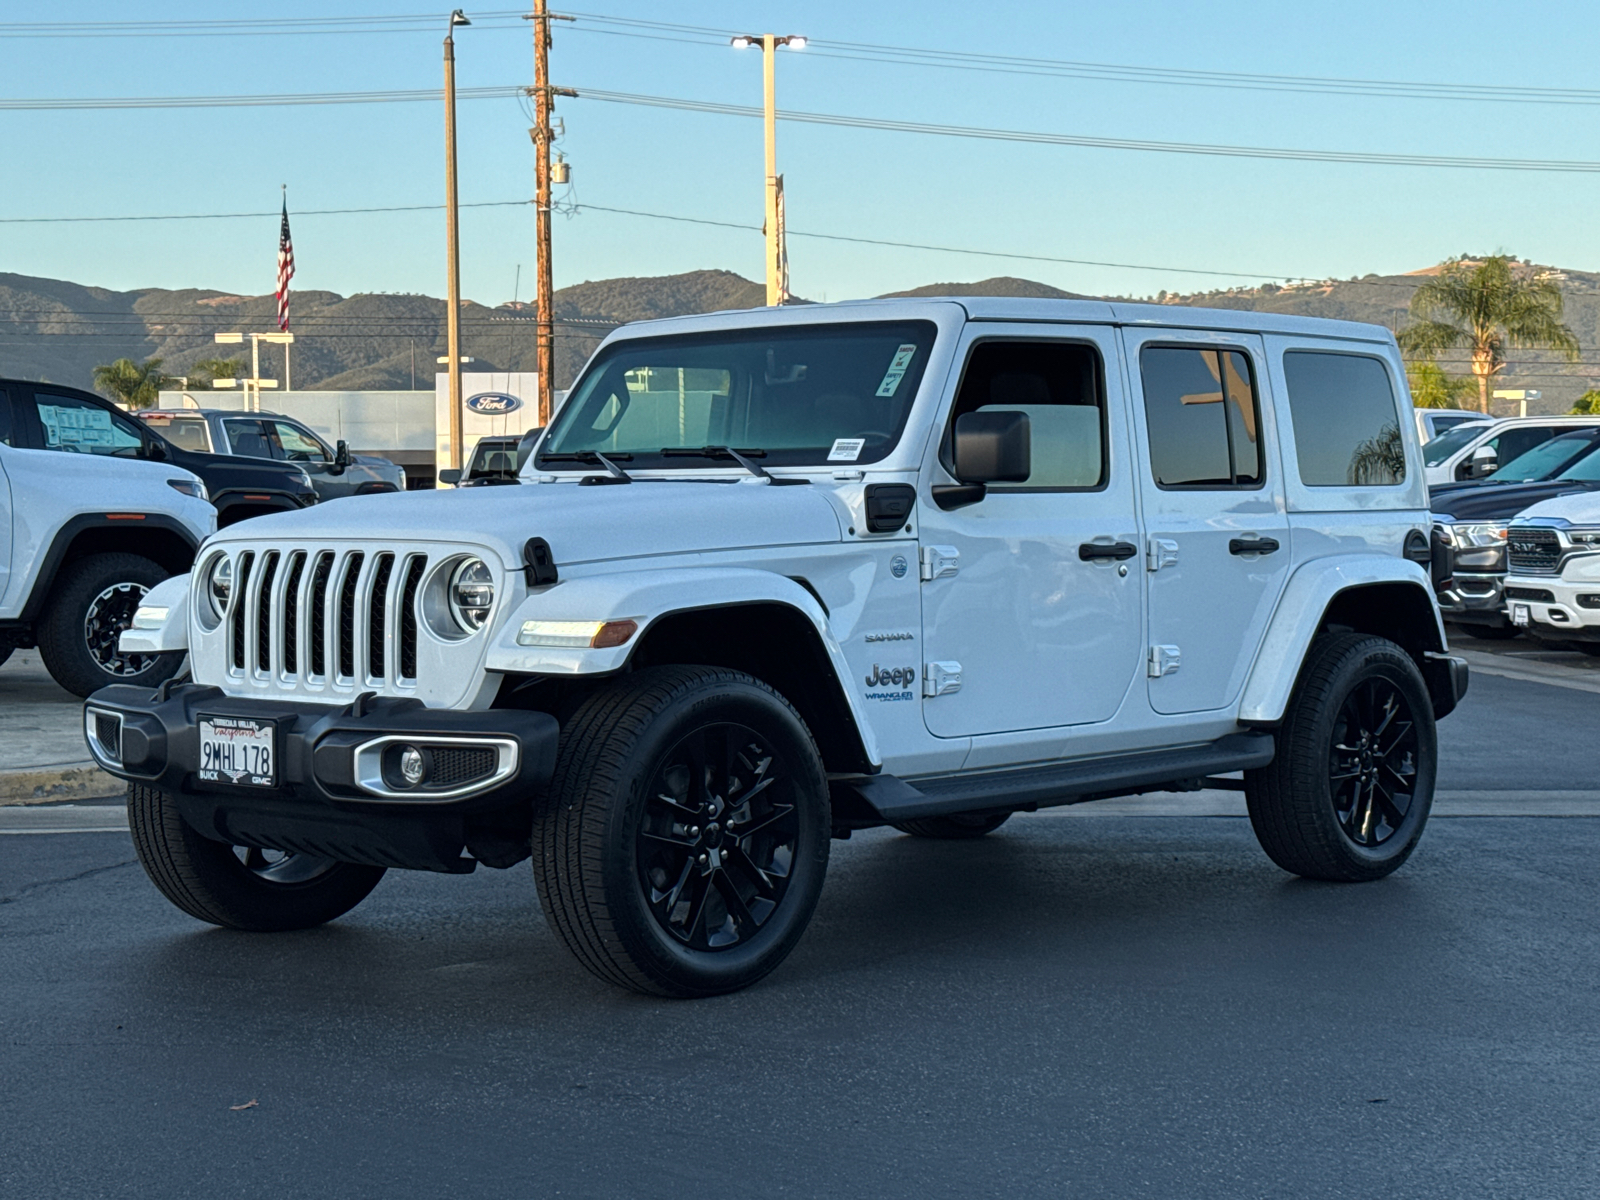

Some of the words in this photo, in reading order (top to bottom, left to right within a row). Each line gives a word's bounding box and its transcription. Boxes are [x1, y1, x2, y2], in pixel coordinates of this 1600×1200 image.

[476, 397, 507, 409] Ford
[865, 632, 914, 642] SAHARA
[865, 663, 915, 689] Jeep
[865, 691, 913, 700] WRANGLER
[237, 720, 256, 729] VALLEY
[214, 727, 261, 740] California
[203, 741, 270, 775] 9MHL178
[200, 770, 218, 780] BUICK
[252, 776, 271, 785] GMC
